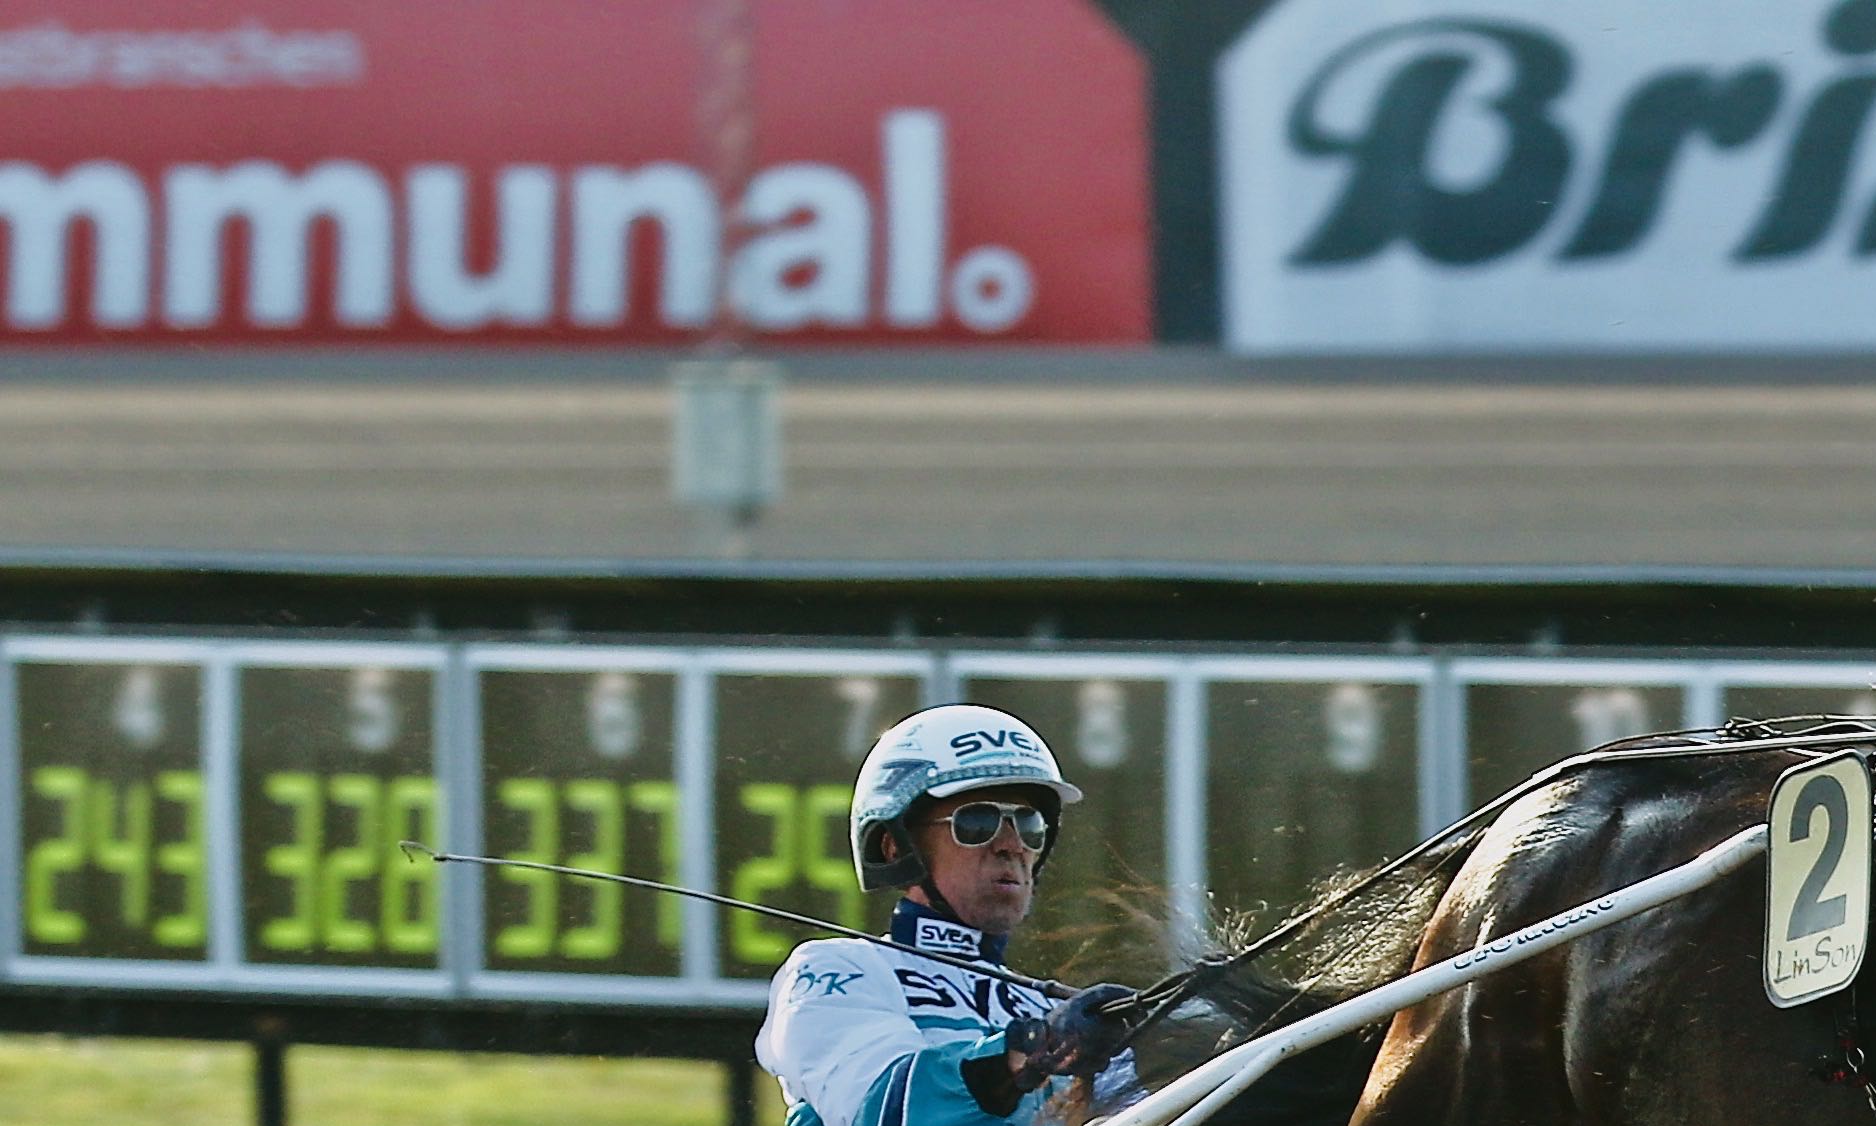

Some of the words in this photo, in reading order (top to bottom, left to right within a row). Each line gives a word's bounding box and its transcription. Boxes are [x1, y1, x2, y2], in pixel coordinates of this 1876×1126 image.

[26, 765, 207, 945] 243
[260, 772, 440, 953] 328
[496, 778, 680, 960] 337
[921, 924, 975, 945] SVEA
[1786, 774, 1848, 942] 2
[1773, 936, 1857, 984] LinSon
